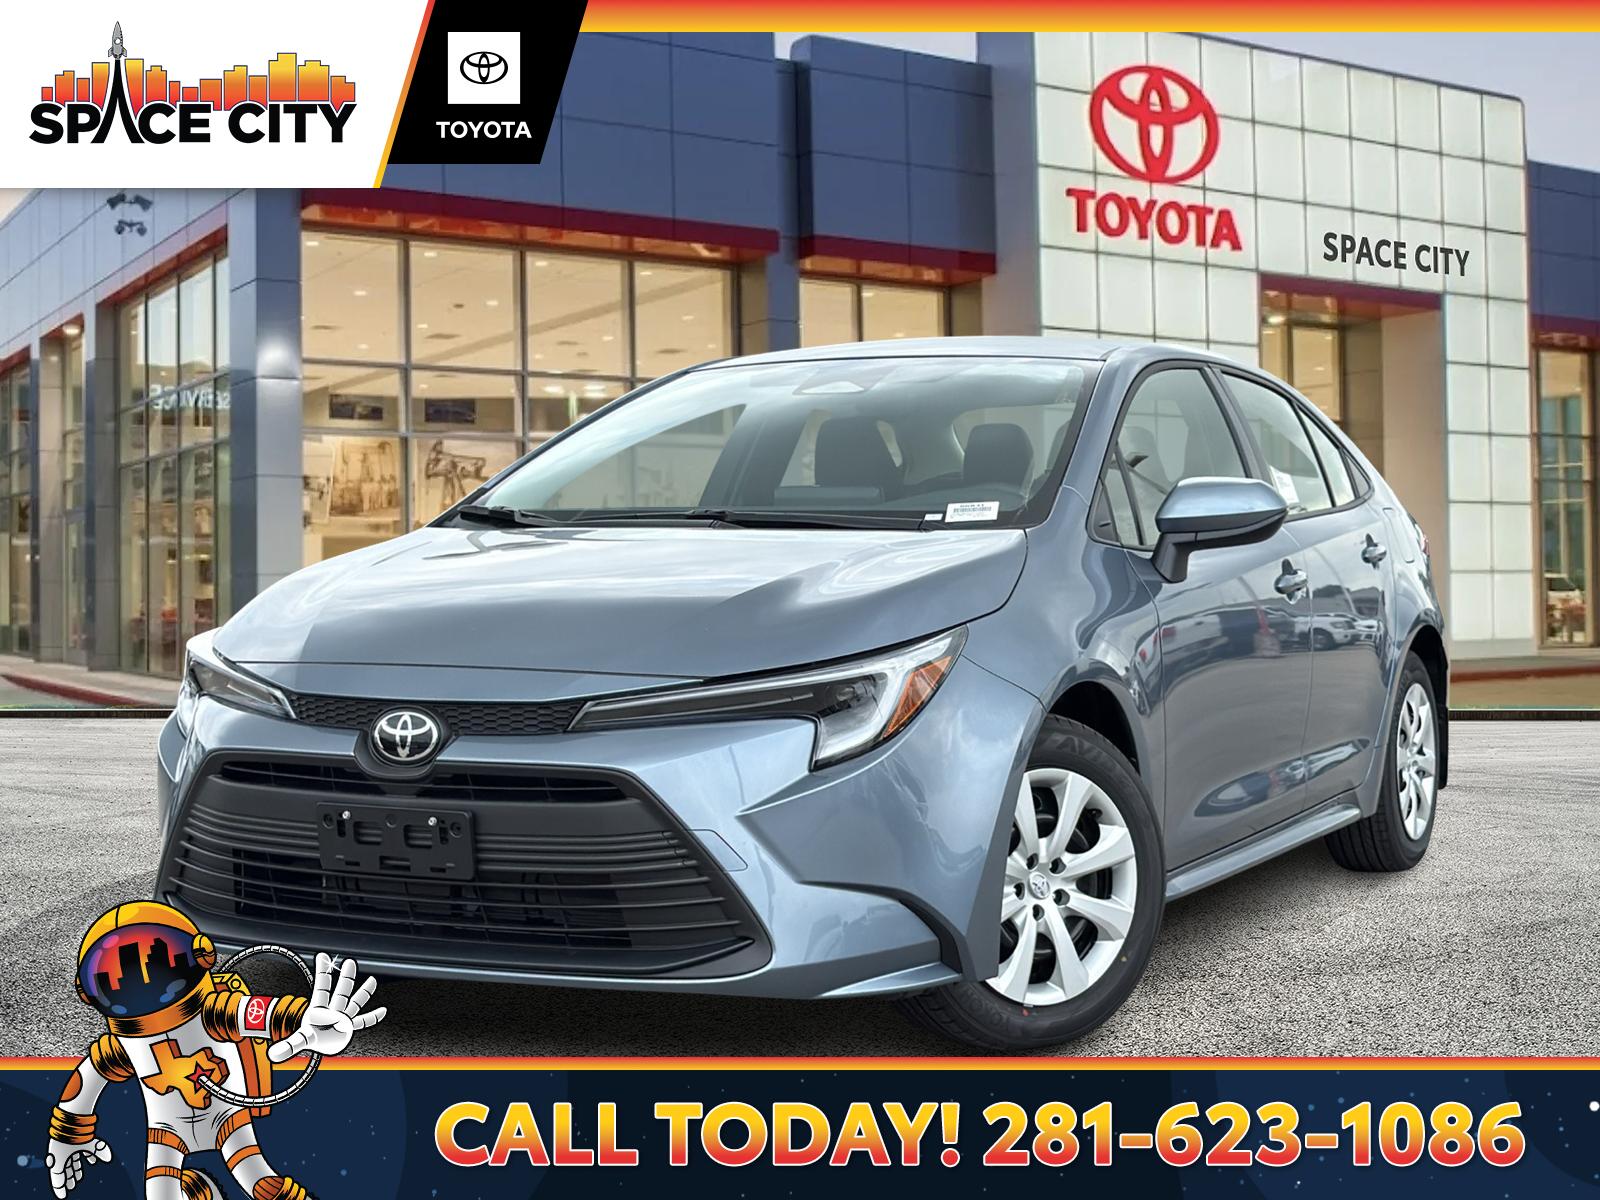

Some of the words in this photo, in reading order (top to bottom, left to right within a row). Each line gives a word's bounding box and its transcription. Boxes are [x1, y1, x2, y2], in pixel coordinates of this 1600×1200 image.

[1066, 187, 1243, 252] TOYOTA
[1323, 232, 1407, 270] SPACE
[1414, 244, 1470, 277] CITY
